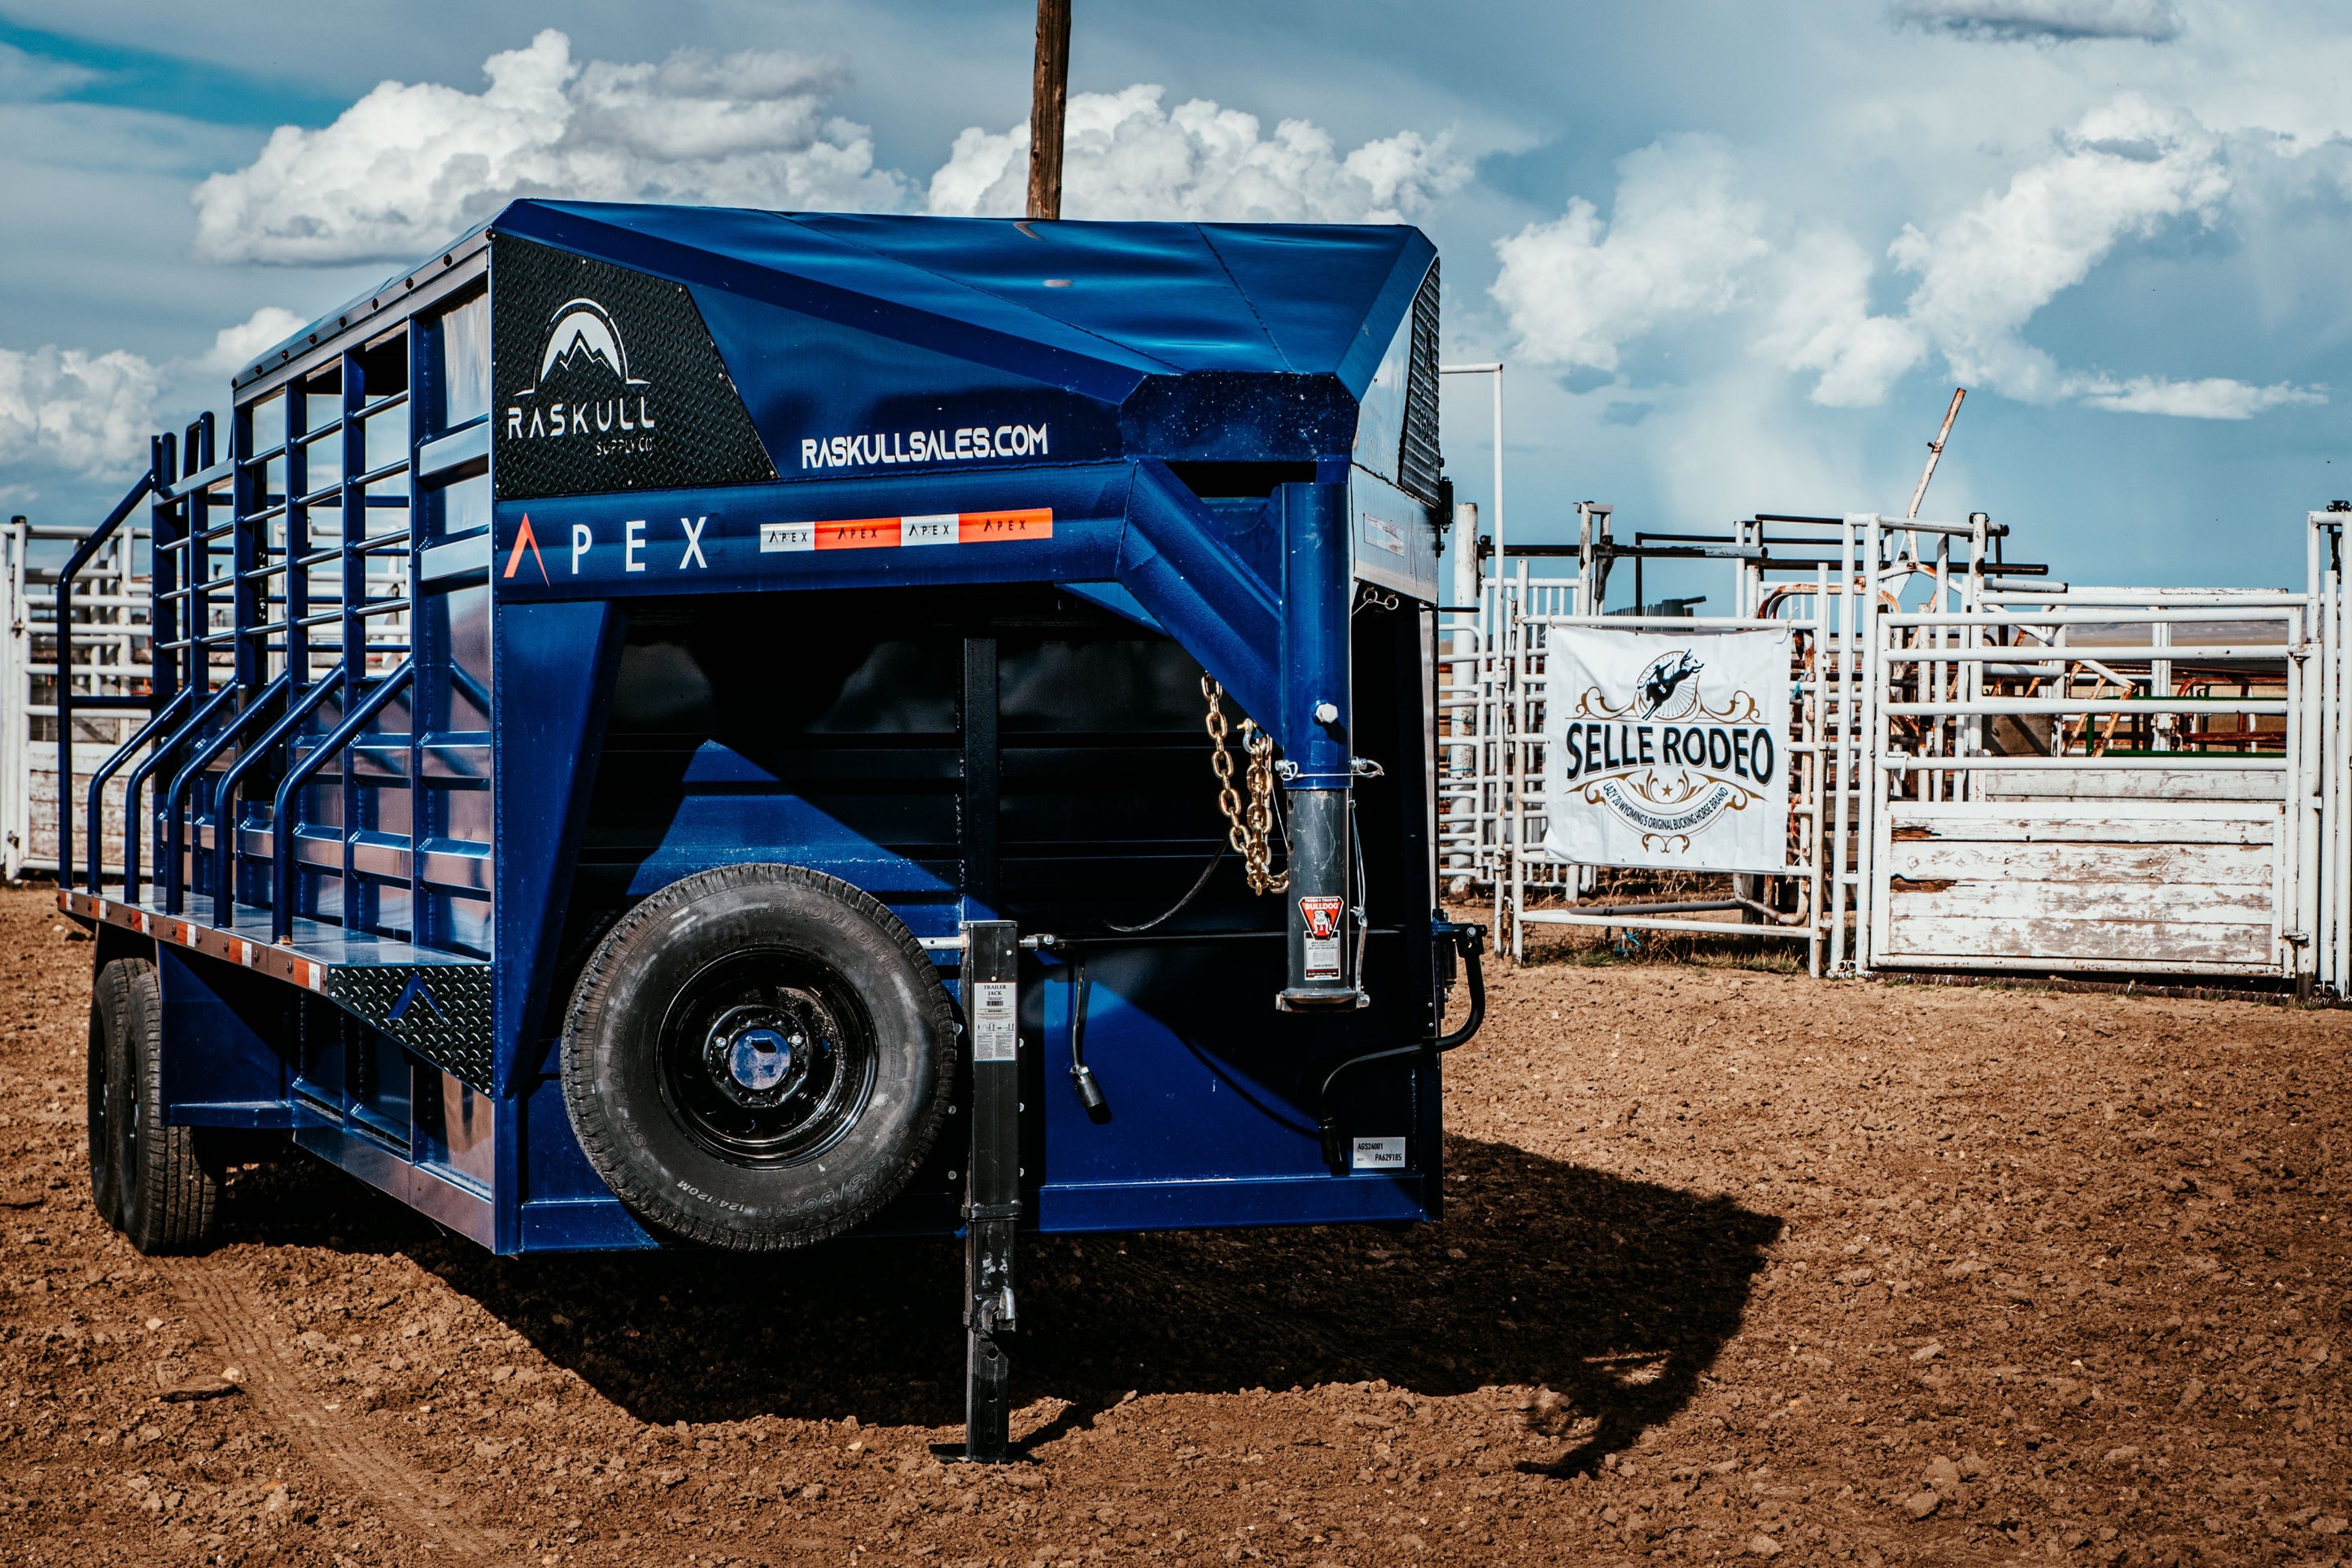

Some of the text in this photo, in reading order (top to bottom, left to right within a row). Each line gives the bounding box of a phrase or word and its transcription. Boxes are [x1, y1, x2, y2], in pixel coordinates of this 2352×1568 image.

[508, 396, 655, 439] RASKULL
[802, 422, 1048, 469] RASKULLSALES.COM
[503, 512, 708, 587] APEX
[769, 519, 1025, 543] APEX APEX APEX APEX
[1566, 722, 1775, 787] SELLE RODEO
[1602, 781, 1729, 830] LAZY 20 WYOMING'S ORIGINAL BUCKING HORSE BRAND
[1305, 902, 1339, 911] BULLDOG
[767, 895, 902, 976] PROVIDER
